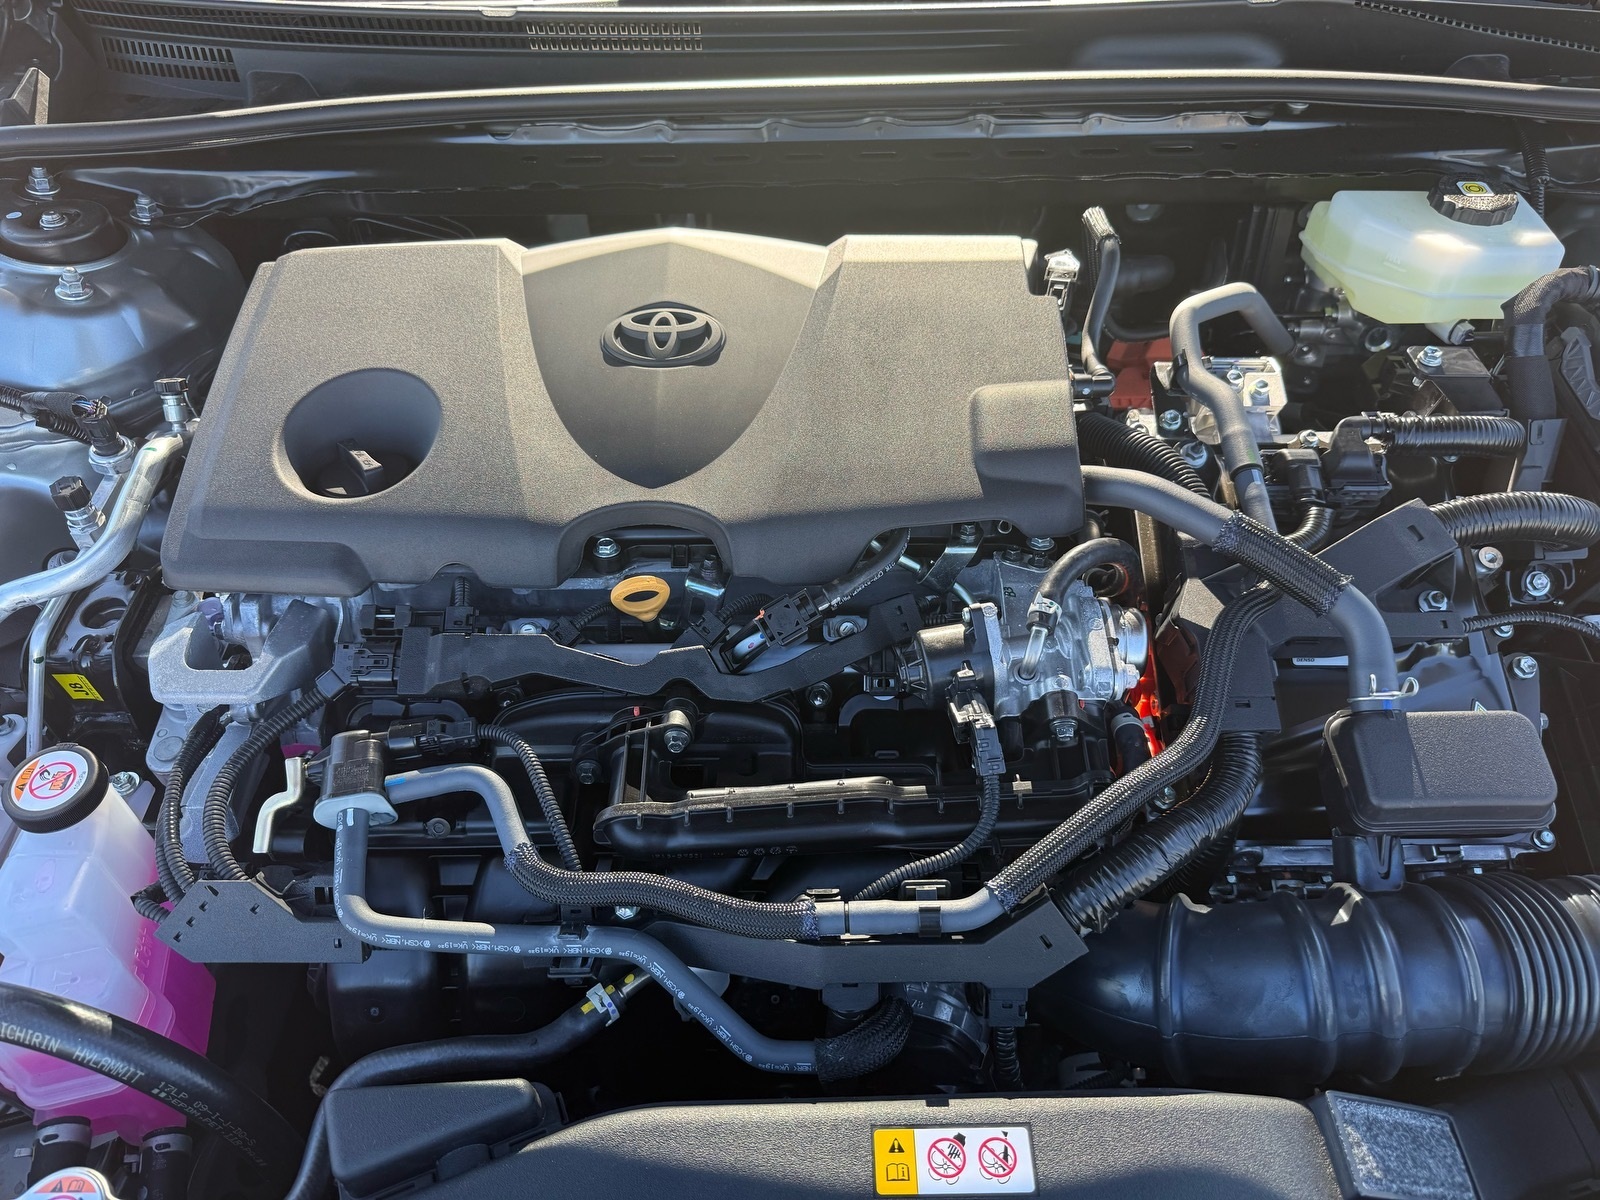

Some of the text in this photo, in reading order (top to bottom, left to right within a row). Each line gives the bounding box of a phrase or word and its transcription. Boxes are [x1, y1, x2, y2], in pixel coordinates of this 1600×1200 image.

[69, 683, 89, 695] J8
[73, 1046, 145, 1083] HYLAMMIT
[159, 1081, 188, 1099] 17LP
